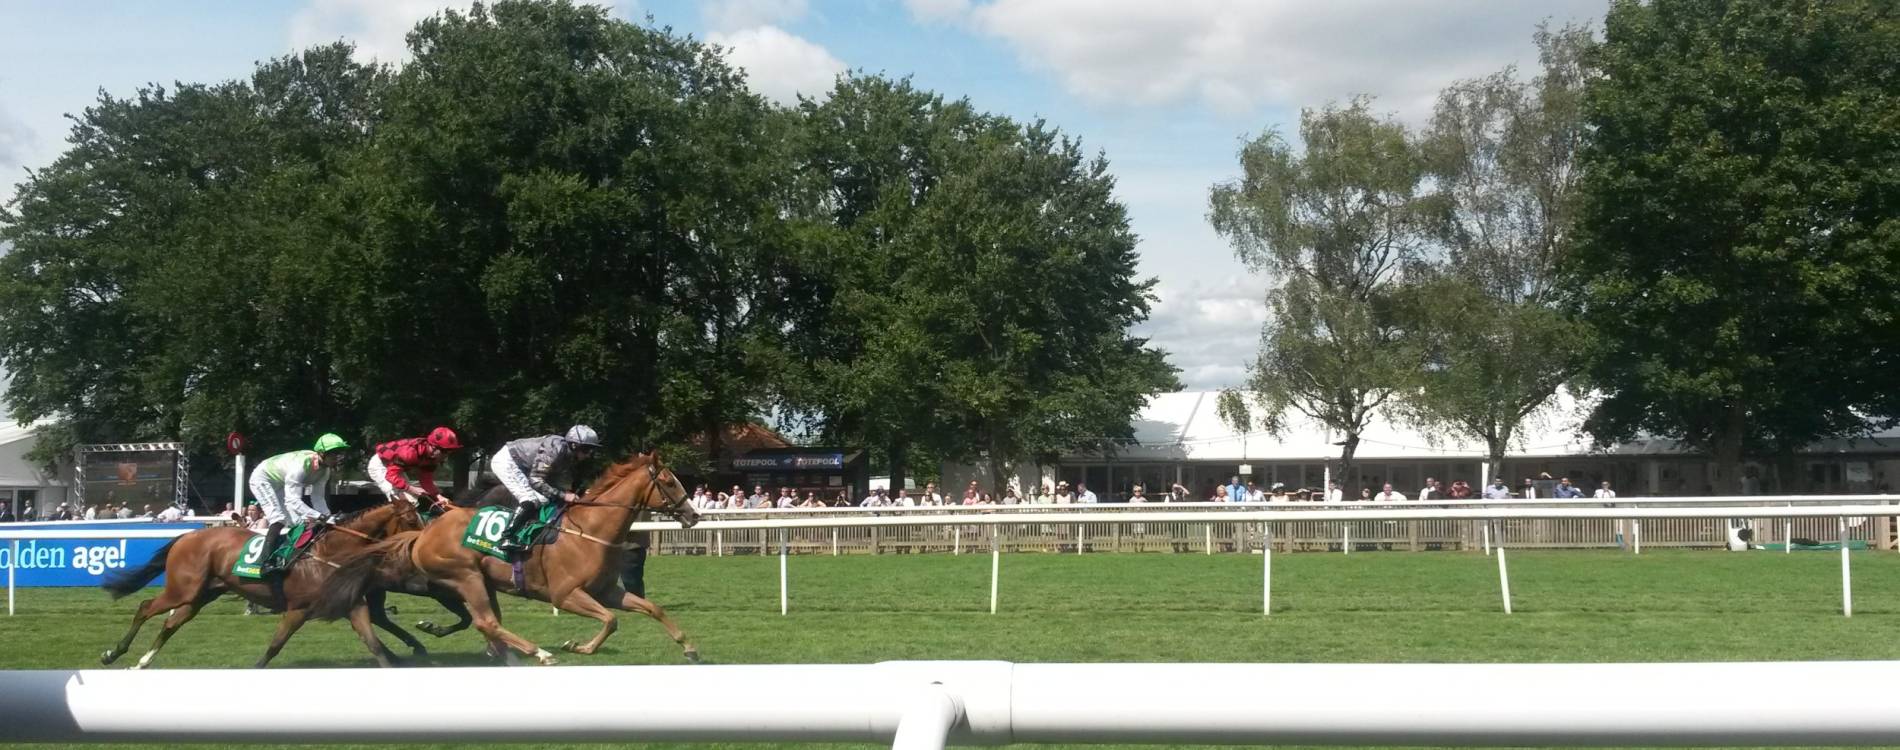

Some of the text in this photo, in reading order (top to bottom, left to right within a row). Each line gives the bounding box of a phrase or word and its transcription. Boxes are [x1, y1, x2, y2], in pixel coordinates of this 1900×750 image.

[475, 510, 509, 542] 16
[72, 539, 127, 575] age!
[244, 536, 266, 564] 9
